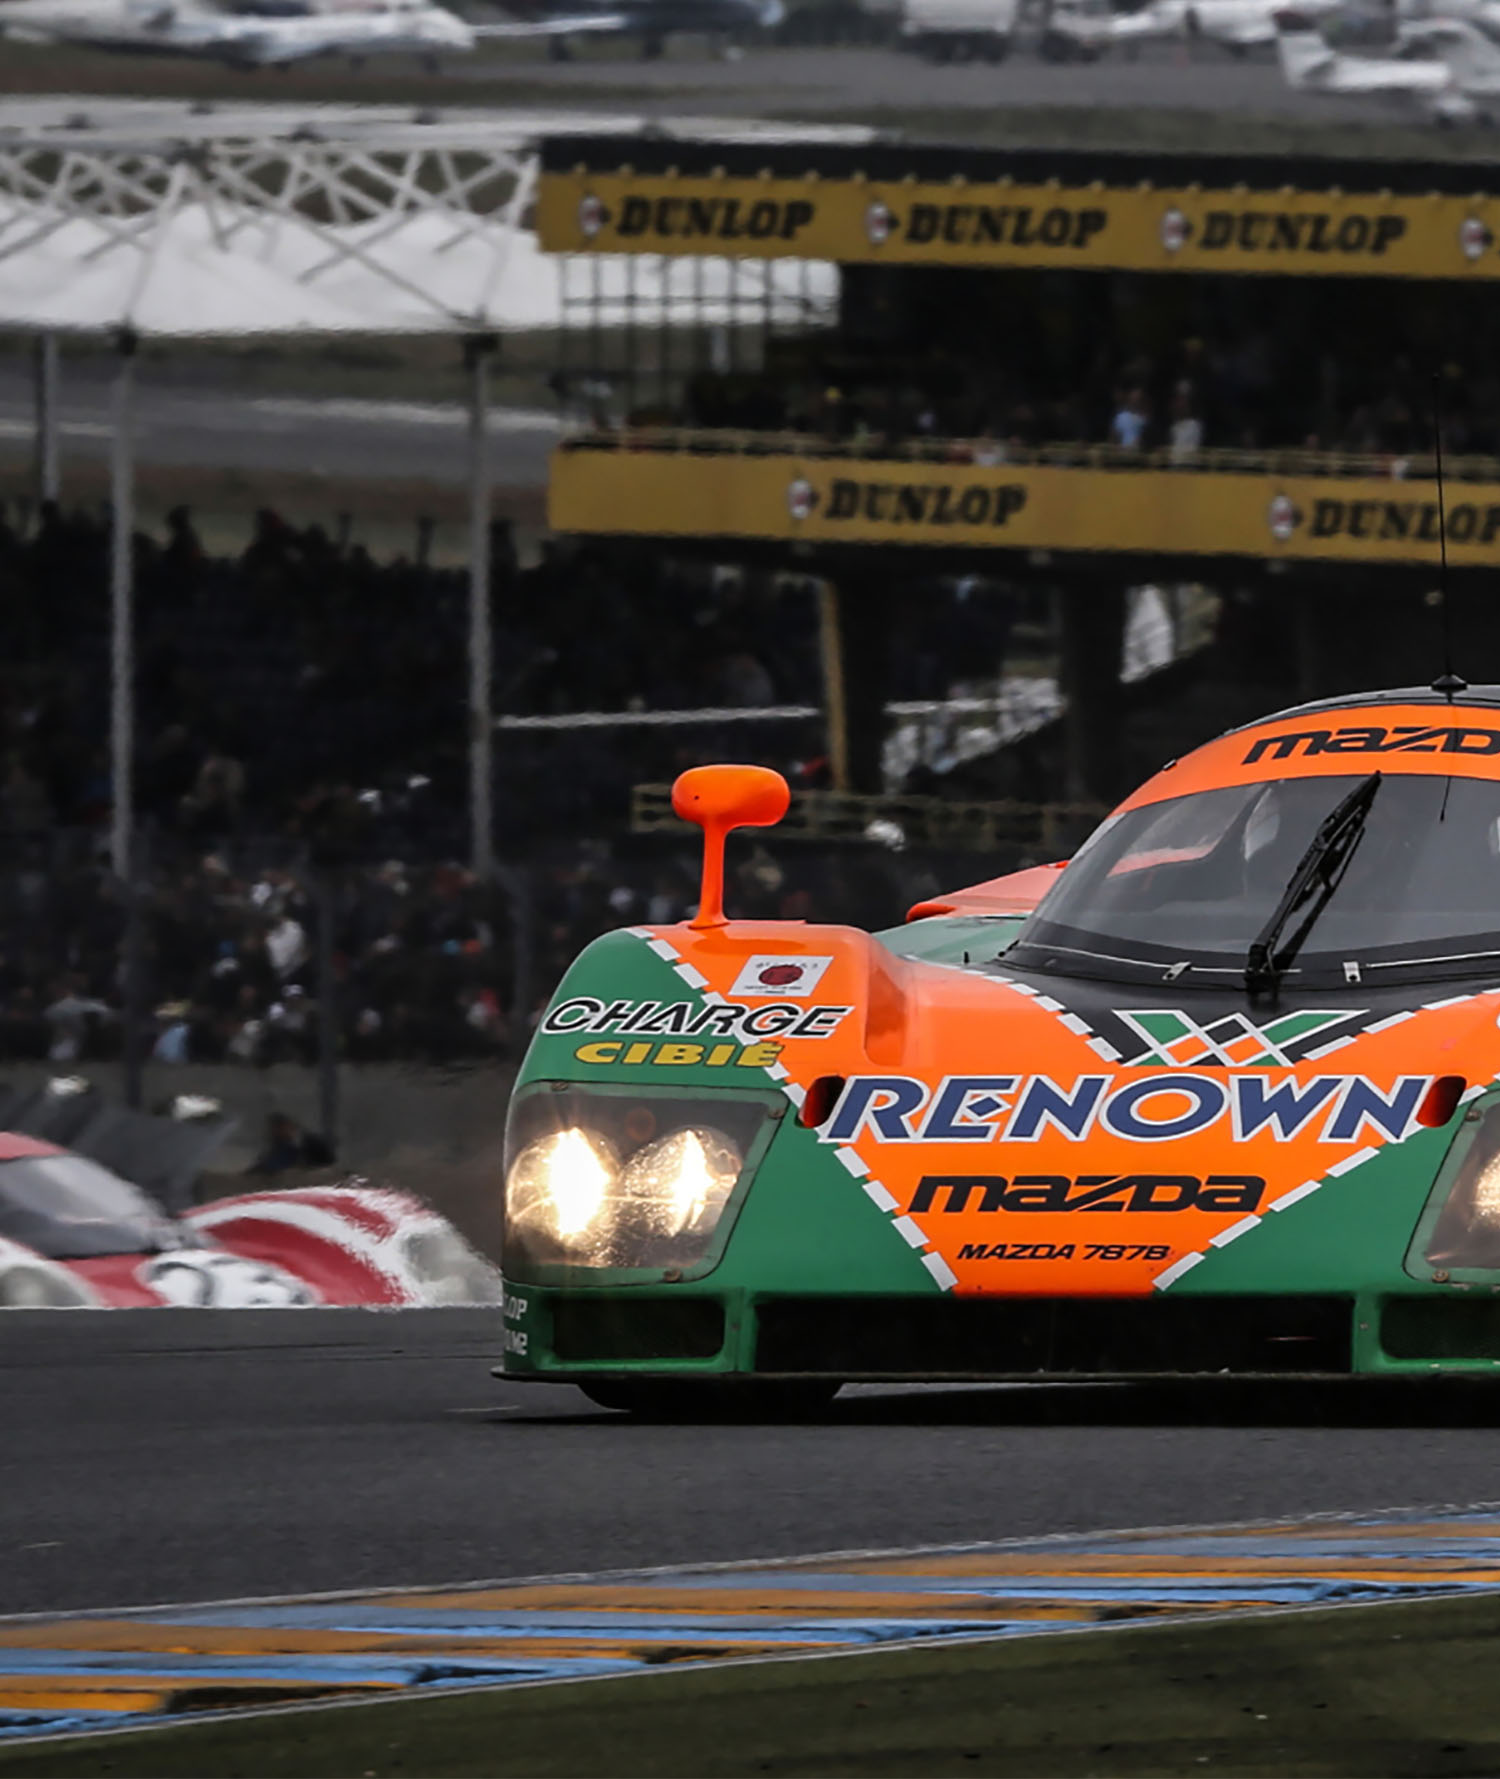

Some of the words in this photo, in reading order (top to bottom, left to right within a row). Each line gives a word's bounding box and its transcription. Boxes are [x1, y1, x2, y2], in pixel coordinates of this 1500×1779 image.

[616, 196, 815, 240] DUNLOP
[904, 203, 1107, 248] DUNLOP
[1198, 211, 1409, 255] DUNLOP
[823, 478, 1028, 526] DUNLOP
[541, 997, 855, 1039] CHARGE
[575, 1041, 785, 1068] CIBIÉ
[817, 1072, 1434, 1144] RENOWN
[906, 1175, 1267, 1213] mazda
[957, 1244, 1074, 1261] MAZDA
[1083, 1244, 1172, 1261] 787B
